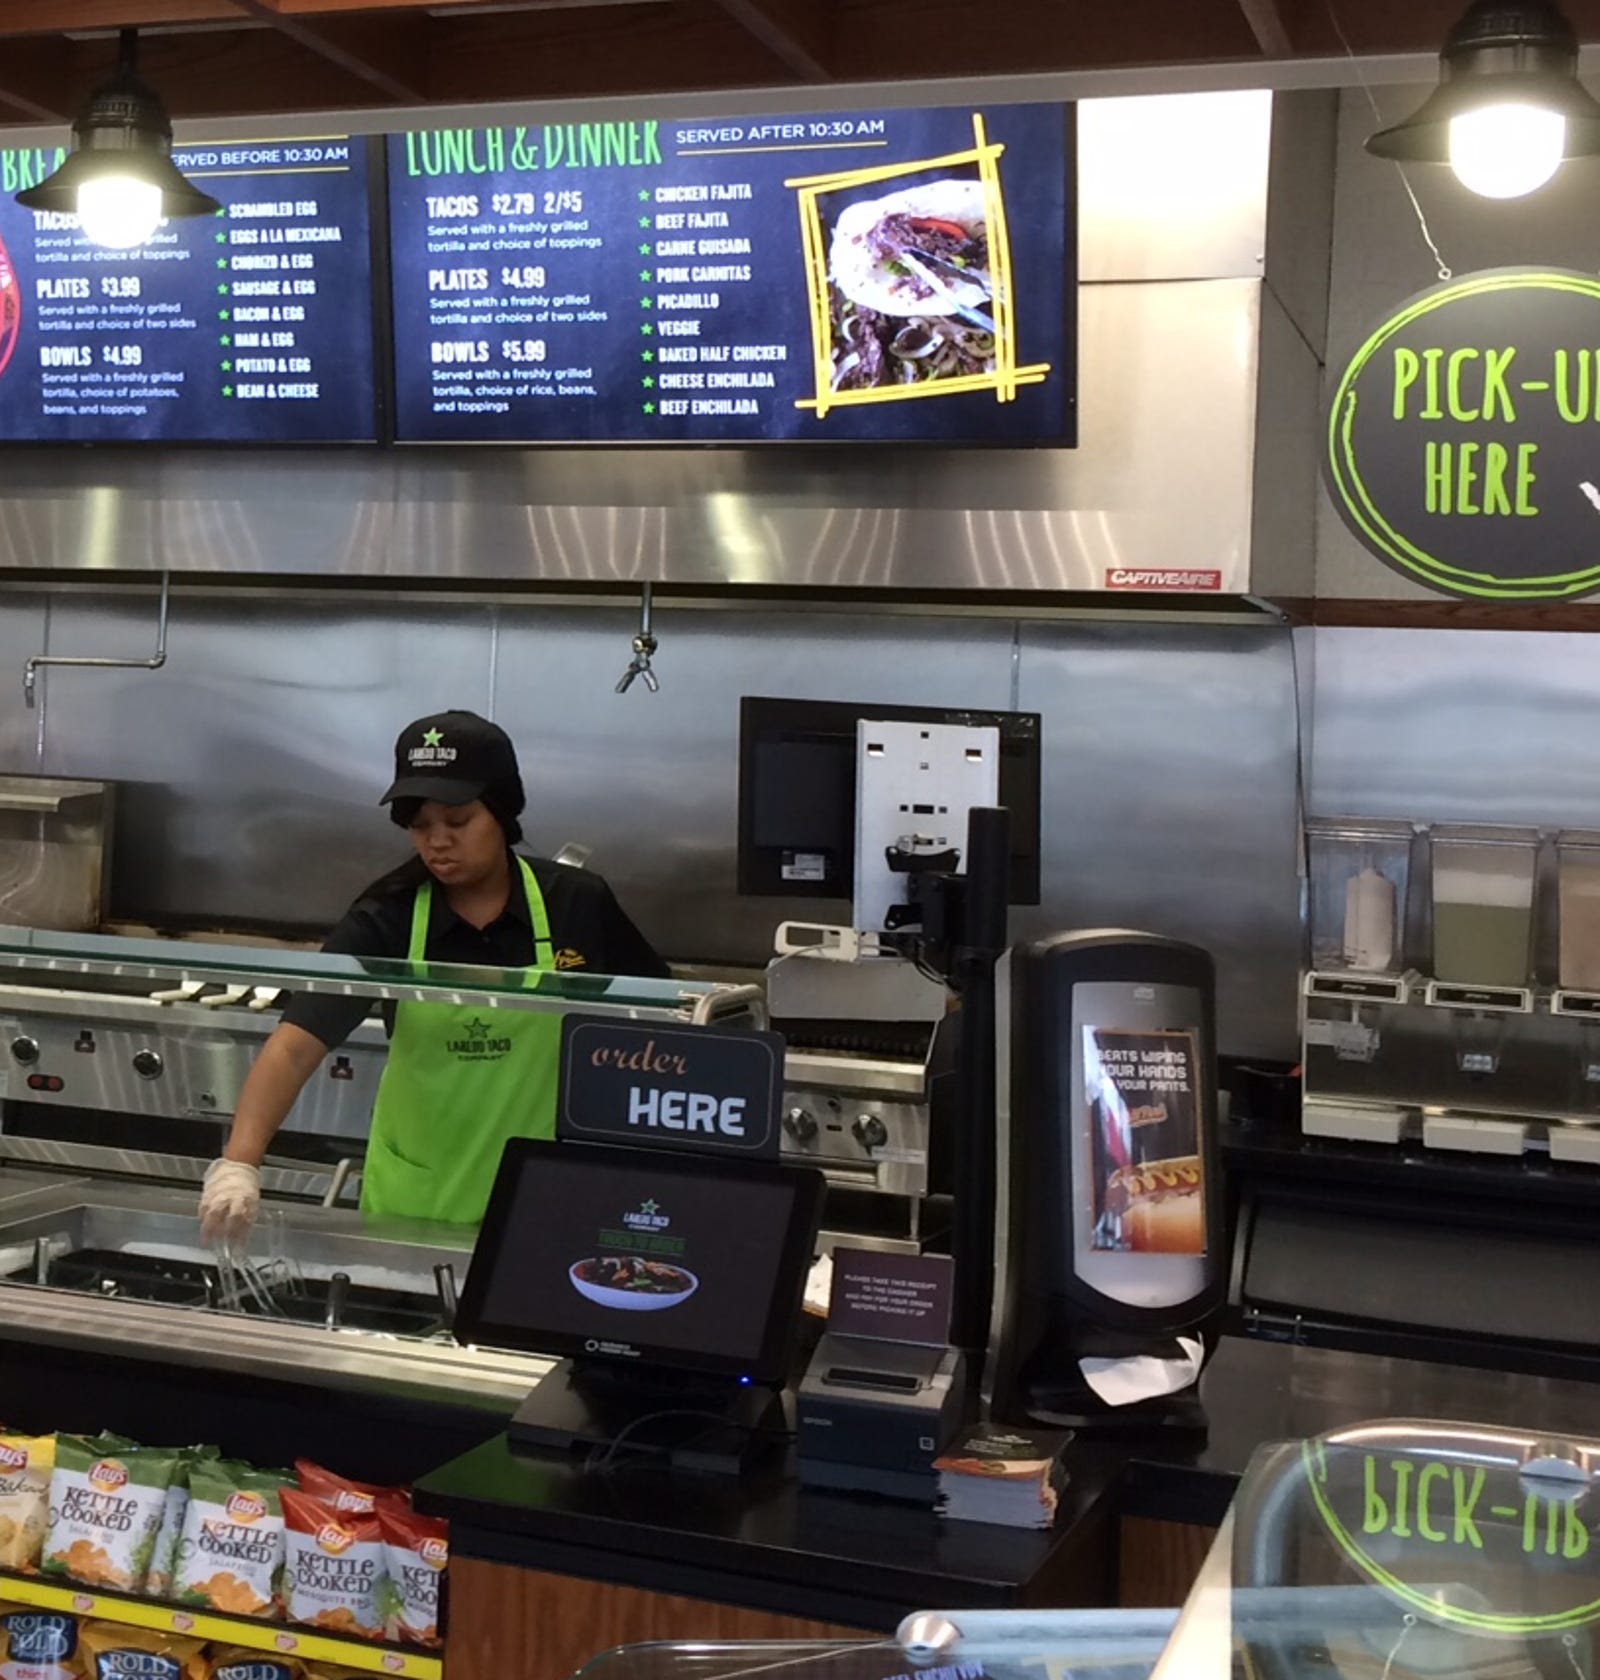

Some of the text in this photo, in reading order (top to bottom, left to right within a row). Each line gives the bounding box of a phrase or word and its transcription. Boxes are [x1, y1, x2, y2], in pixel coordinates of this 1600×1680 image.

[676, 120, 885, 144] SERVED AFTER 10:30 AM
[406, 120, 662, 176] LUNCH & DINNER
[171, 147, 348, 167] ERVED BEFORE 10:30 AM
[655, 184, 752, 203] CHICKEN FAJITA
[229, 200, 318, 218] SCRAMBLED EGG
[425, 191, 582, 218] TACOS $2.79 2/$5
[427, 220, 589, 237] Served with a freshly grilled
[655, 212, 729, 230] BEEF FAJITA
[260, 229, 268, 243] A
[269, 228, 283, 243] LA
[285, 227, 341, 243] MEXICANA
[427, 236, 603, 253] tortilla and choice of toppings
[656, 238, 751, 257] CARNE GUISADA
[280, 254, 289, 269] &
[291, 254, 313, 269] EGG
[429, 266, 545, 291] PLATES $4.99
[657, 265, 751, 283] PORK CARNITAS
[36, 276, 141, 299] PLATES $3.99
[232, 280, 316, 296] SAUSAGE & EGG
[430, 294, 590, 309] Served with a freshly grilled
[657, 293, 719, 309] PICADILLO
[233, 306, 305, 322] BACON & EGG
[430, 311, 608, 325] tortilla and choice of two sides
[657, 320, 701, 336] VEGGIE
[234, 331, 295, 347] HAM & EGG
[40, 345, 142, 366] BOWLS $4.99
[431, 339, 546, 363] BOWLS $5.99
[659, 345, 787, 362] BAKED HALF CHICKEN
[235, 357, 311, 373] POTATO & EGG
[432, 367, 592, 381] Served with a freshly grilled
[659, 372, 775, 389] CHEESE ENCHILADA
[236, 383, 320, 398] BEAN & CHEESE
[433, 384, 597, 397] tortilla, choice of rice, beans,
[1393, 346, 1600, 424] PICK-U
[433, 400, 510, 413] and toppings
[660, 399, 759, 415] BEEF ENCHILADA
[1424, 441, 1540, 517] HERE
[436, 747, 457, 761] TACO
[487, 1038, 511, 1052] TACO
[591, 1040, 689, 1075] order
[1141, 1051, 1187, 1064] WIPING
[1104, 1064, 1187, 1079] OUR HANDS
[1117, 1080, 1147, 1090] YOUR
[628, 1086, 746, 1136] HERE
[109, 1653, 169, 1675] ROLD
